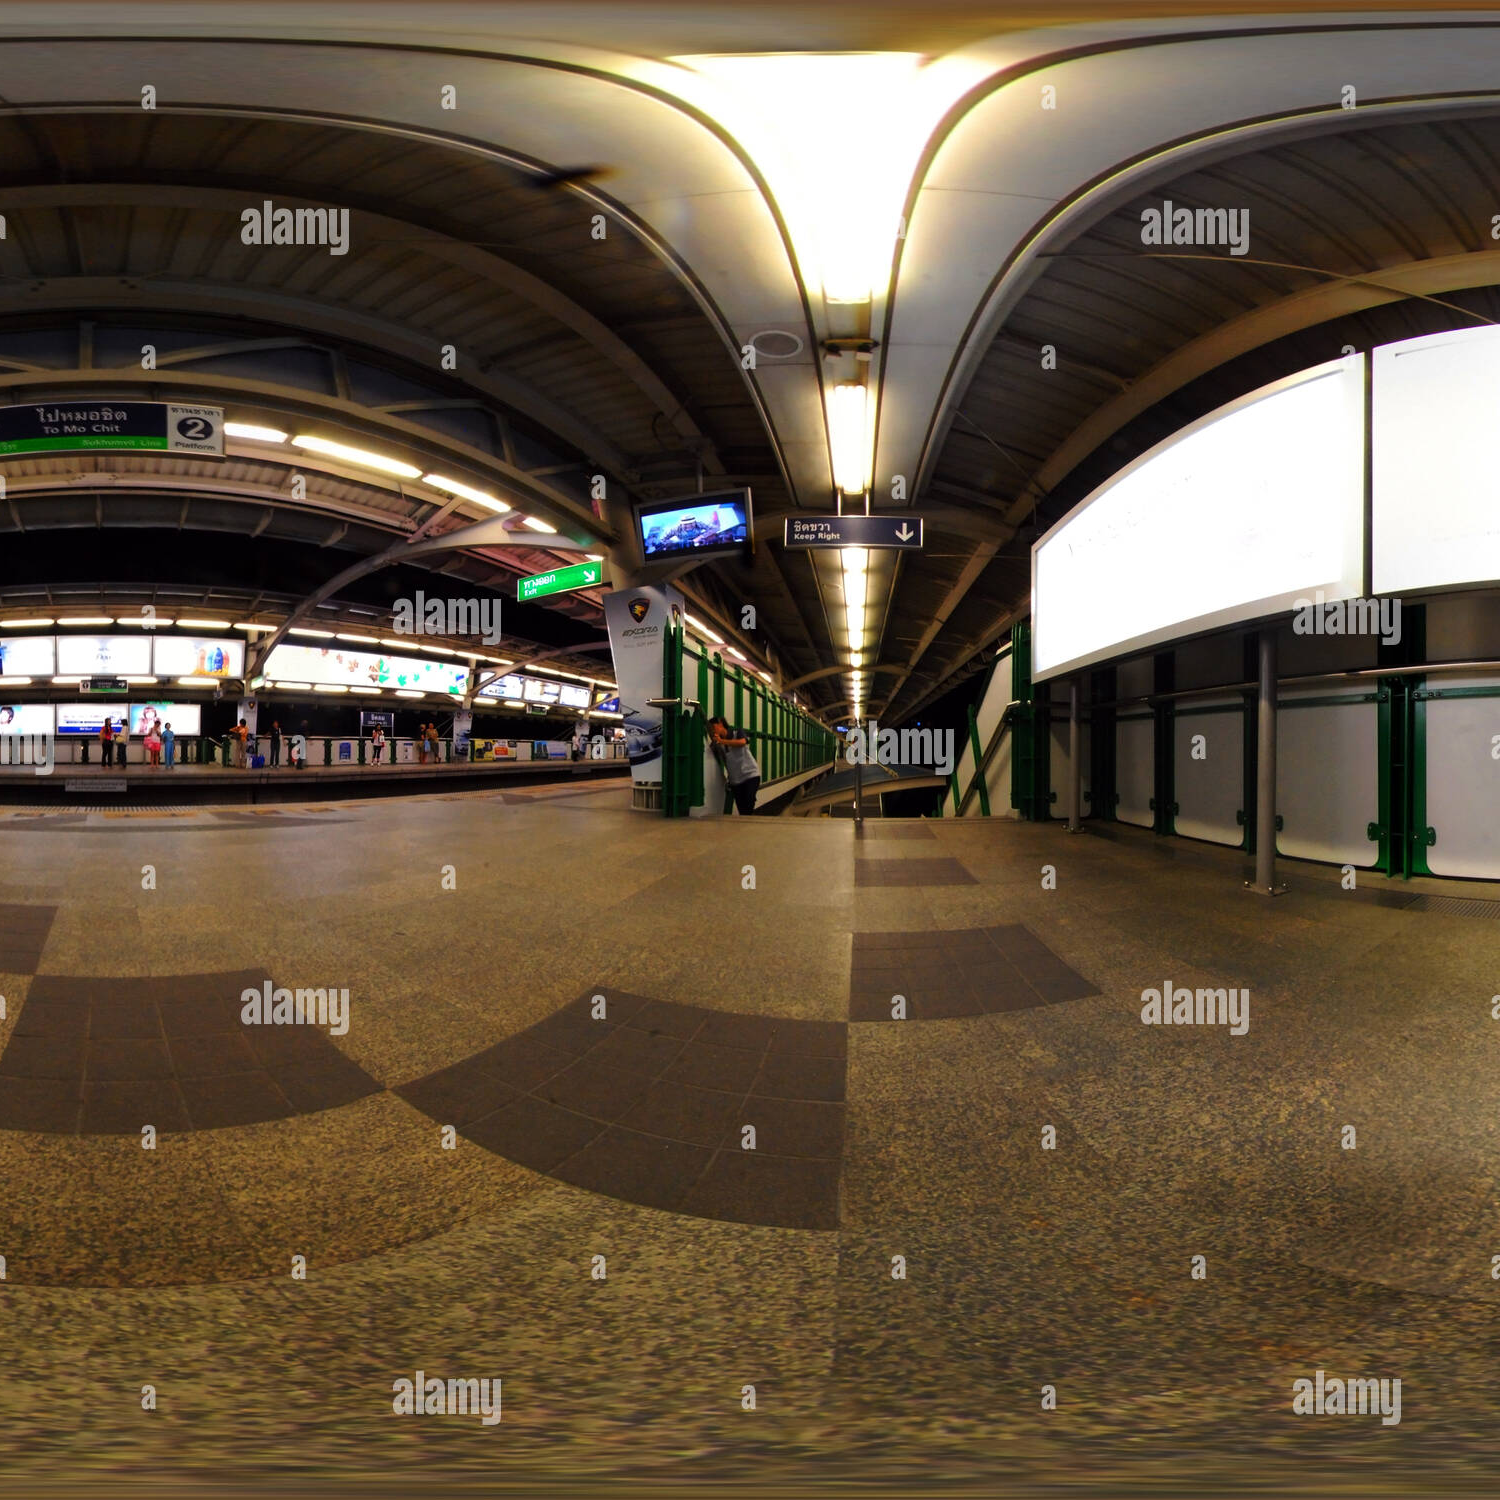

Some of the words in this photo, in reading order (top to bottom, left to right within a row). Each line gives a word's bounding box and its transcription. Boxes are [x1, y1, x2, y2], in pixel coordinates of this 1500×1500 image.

[35, 407, 128, 422] ไปหมอชิต
[43, 426, 60, 434] To
[63, 424, 87, 433] Mo
[92, 424, 121, 433] Chit
[185, 418, 206, 438] 2
[174, 441, 216, 451] Platform
[793, 521, 831, 532] ชิดขวา
[794, 533, 816, 541] Keep
[818, 532, 841, 541] Right
[523, 574, 556, 589] ทางออก
[524, 588, 538, 596] Exit
